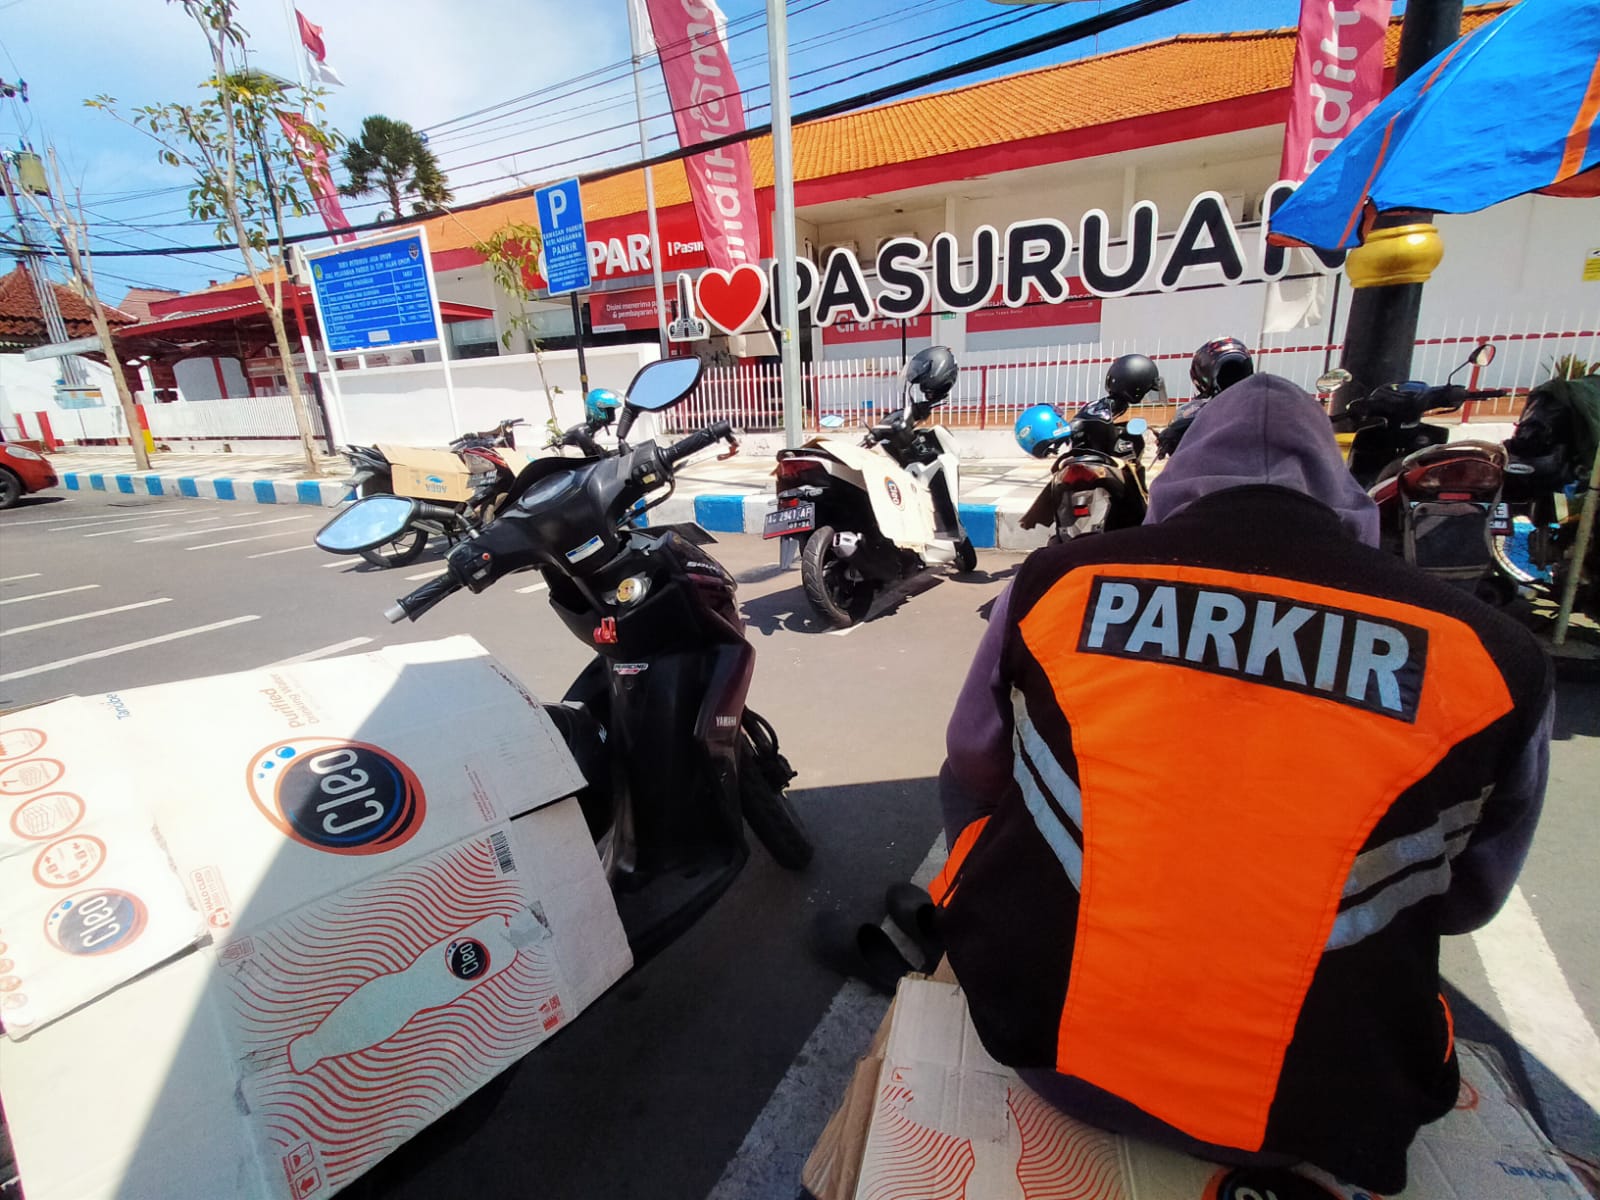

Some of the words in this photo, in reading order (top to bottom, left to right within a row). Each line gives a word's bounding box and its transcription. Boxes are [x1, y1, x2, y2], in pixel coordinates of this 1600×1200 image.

[548, 190, 567, 228] P
[552, 241, 577, 257] PARKIR
[1087, 582, 1410, 712] PARKIR
